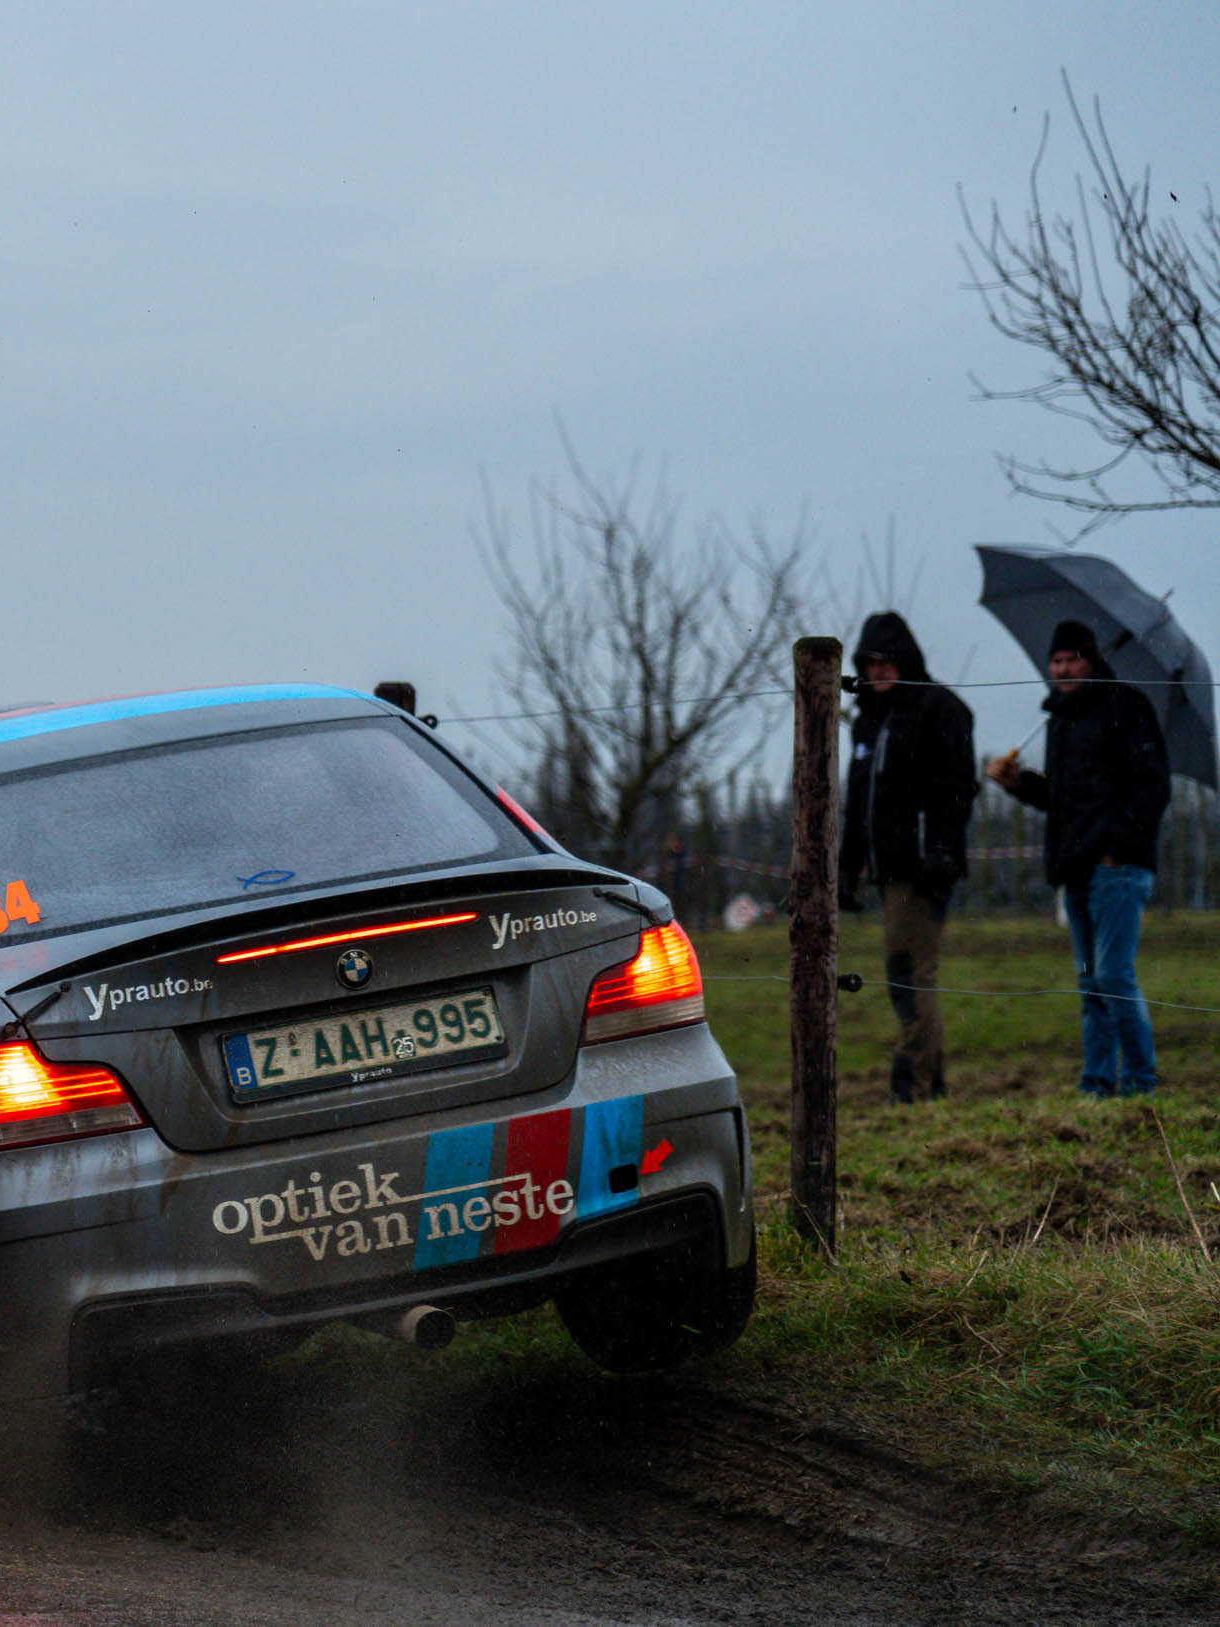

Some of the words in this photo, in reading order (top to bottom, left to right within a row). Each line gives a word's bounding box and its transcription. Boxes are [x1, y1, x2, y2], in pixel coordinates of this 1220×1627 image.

[393, 1036, 414, 1055] 25
[236, 1065, 253, 1086] B
[212, 1163, 404, 1245] optiek
[300, 1213, 416, 1262] van
[424, 1173, 576, 1240] neste
